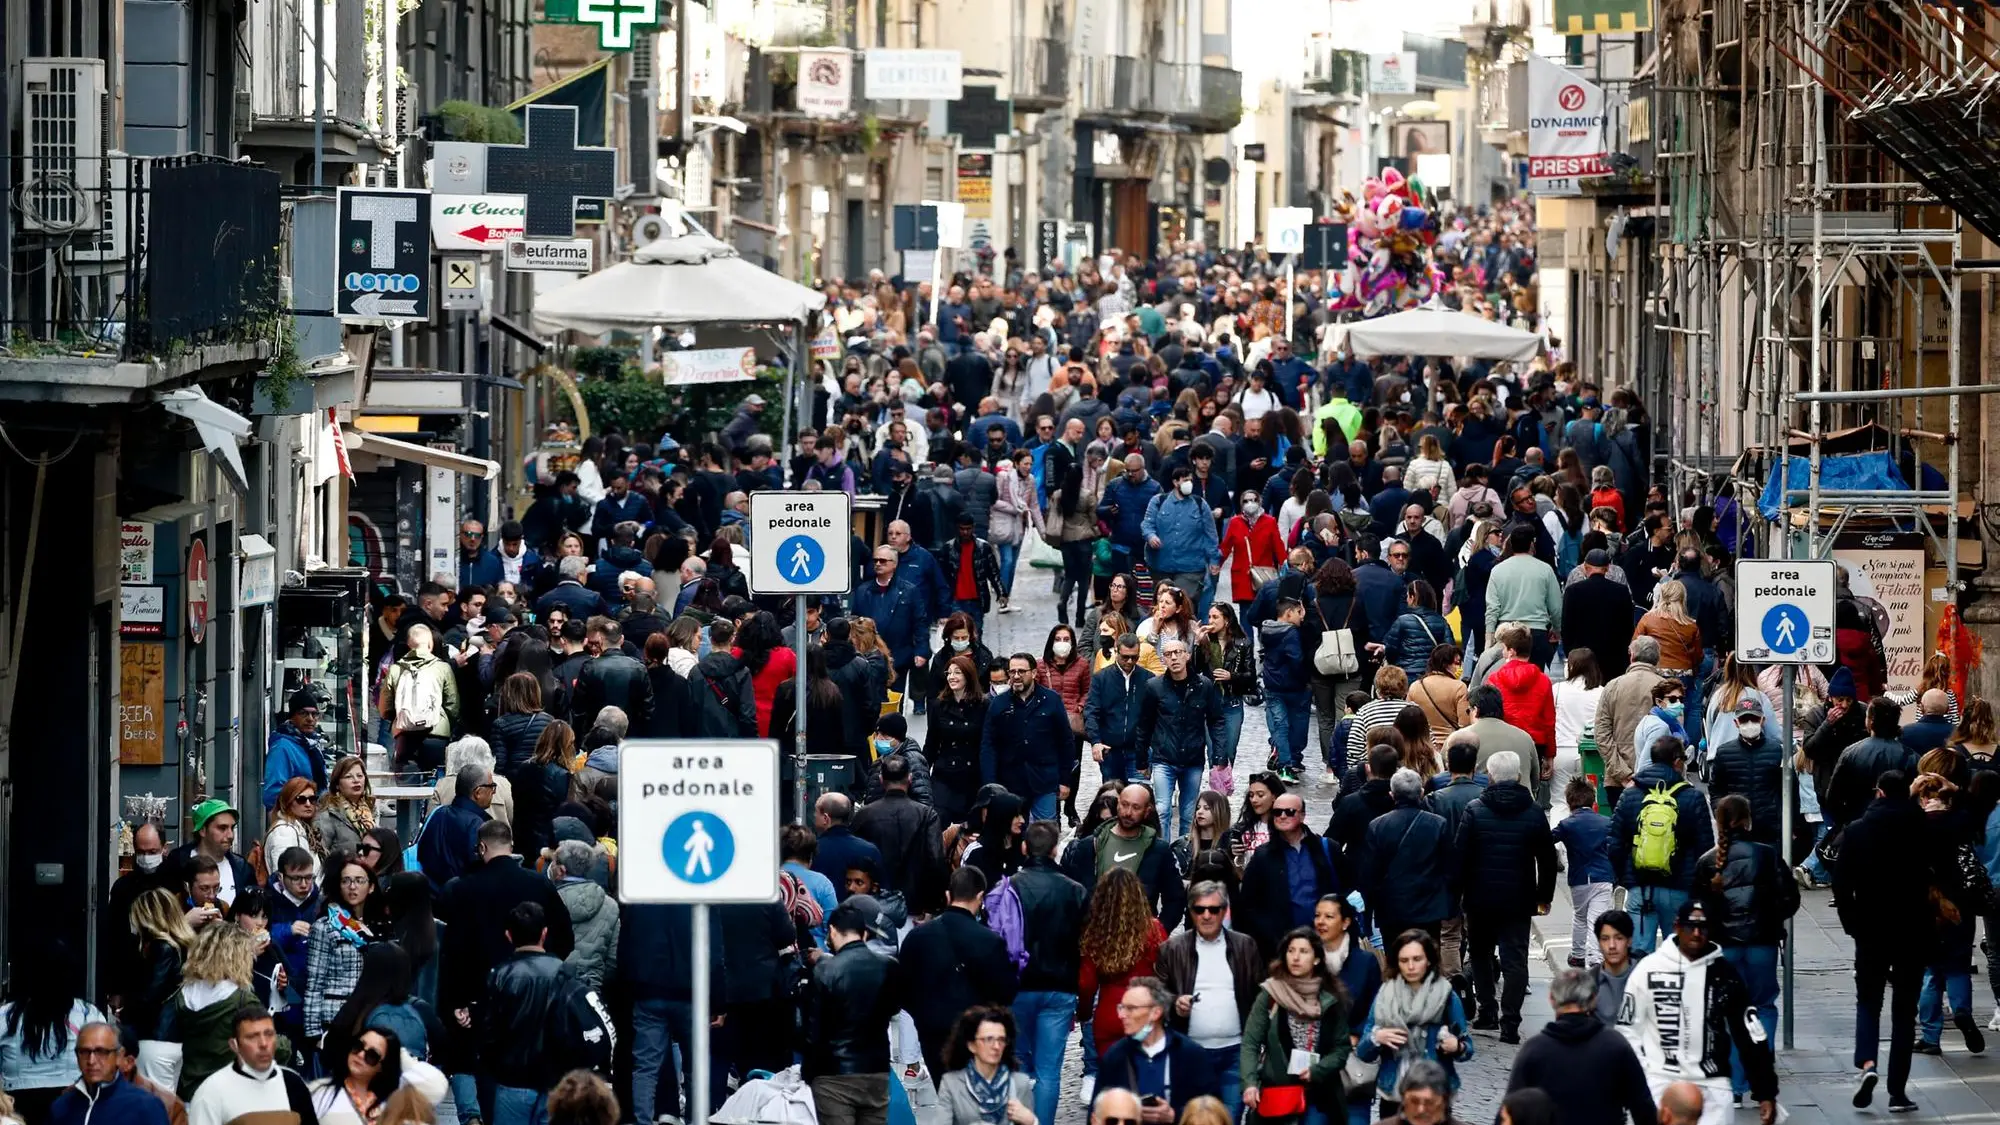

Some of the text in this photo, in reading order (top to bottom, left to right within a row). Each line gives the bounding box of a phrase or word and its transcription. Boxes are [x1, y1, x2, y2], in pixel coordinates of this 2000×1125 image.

[469, 202, 525, 216] Cucc
[527, 245, 587, 259] eufarma
[345, 272, 420, 292] LOTTO
[785, 503, 814, 512] area
[769, 517, 831, 529] pedonale
[1771, 571, 1799, 580] area
[1870, 572, 1912, 582] comprare
[1754, 585, 1816, 597] pedonale
[1890, 601, 1909, 610] ma
[1896, 612, 1904, 622] si
[1892, 625, 1912, 637] può
[1884, 645, 1921, 657] omprare
[1888, 658, 1920, 677] lato
[119, 705, 153, 722] BEER
[672, 756, 724, 769] area
[642, 779, 754, 799] pedonale
